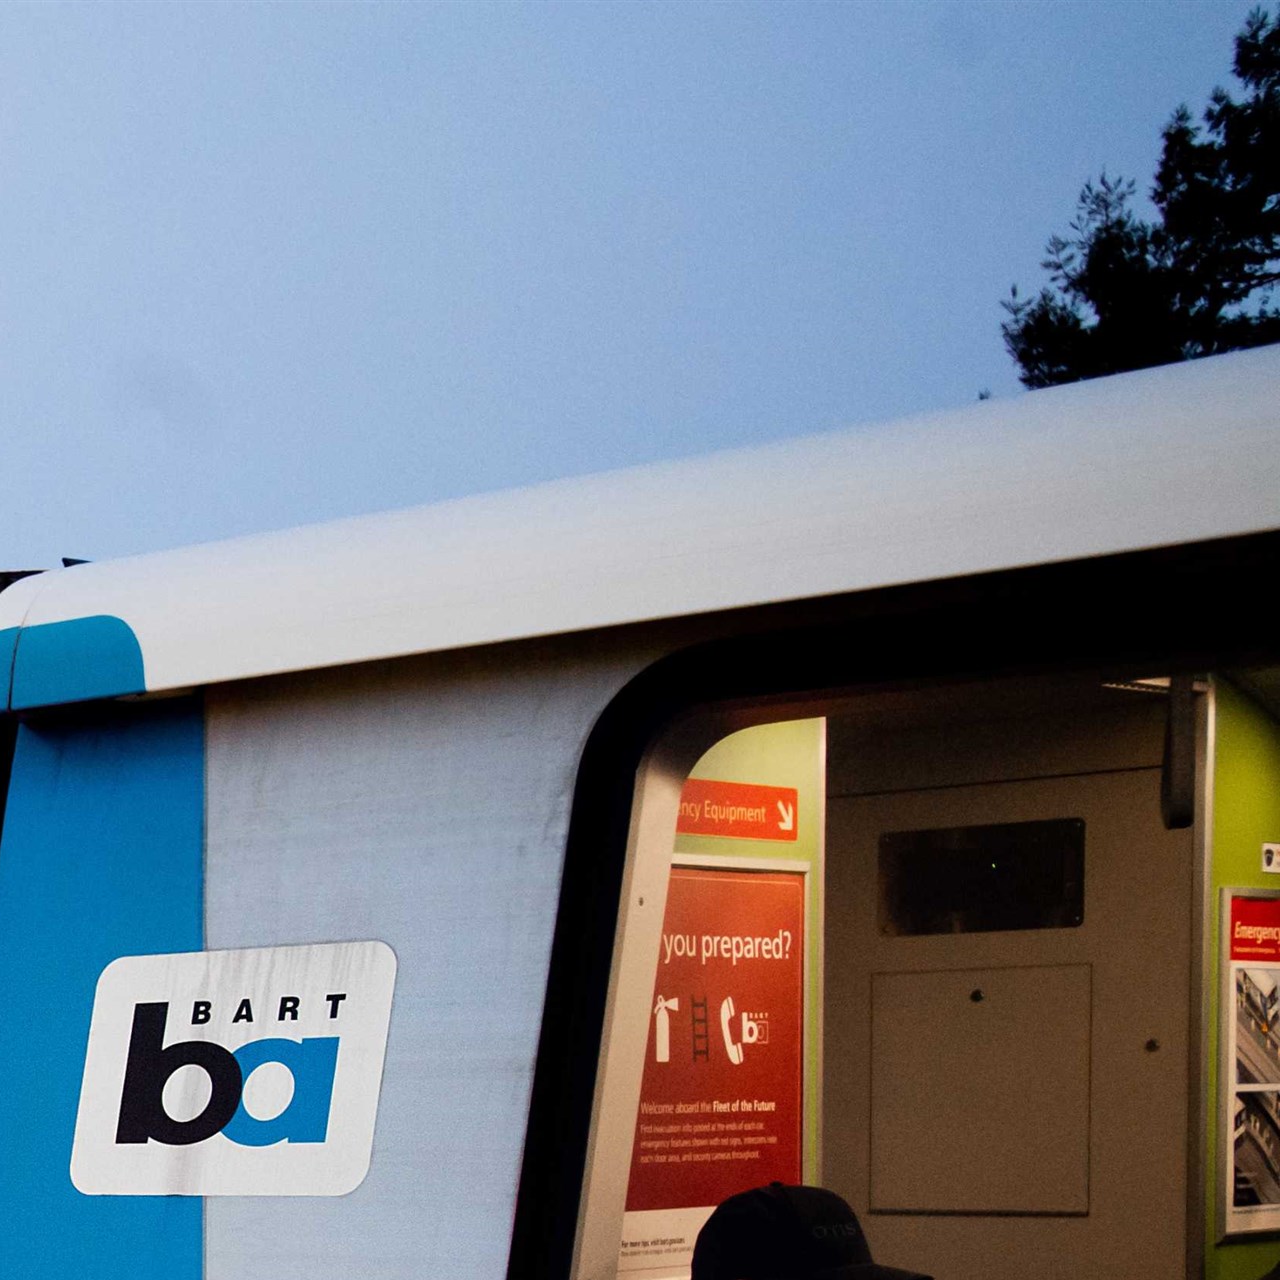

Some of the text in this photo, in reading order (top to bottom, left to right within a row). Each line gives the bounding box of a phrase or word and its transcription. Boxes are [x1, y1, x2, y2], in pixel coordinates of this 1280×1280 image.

[679, 800, 766, 824] ncy Equipment
[663, 929, 792, 966] you prepared?
[191, 993, 347, 1025] BART
[640, 1099, 776, 1114] Welcome aboard the Fleet of the Future
